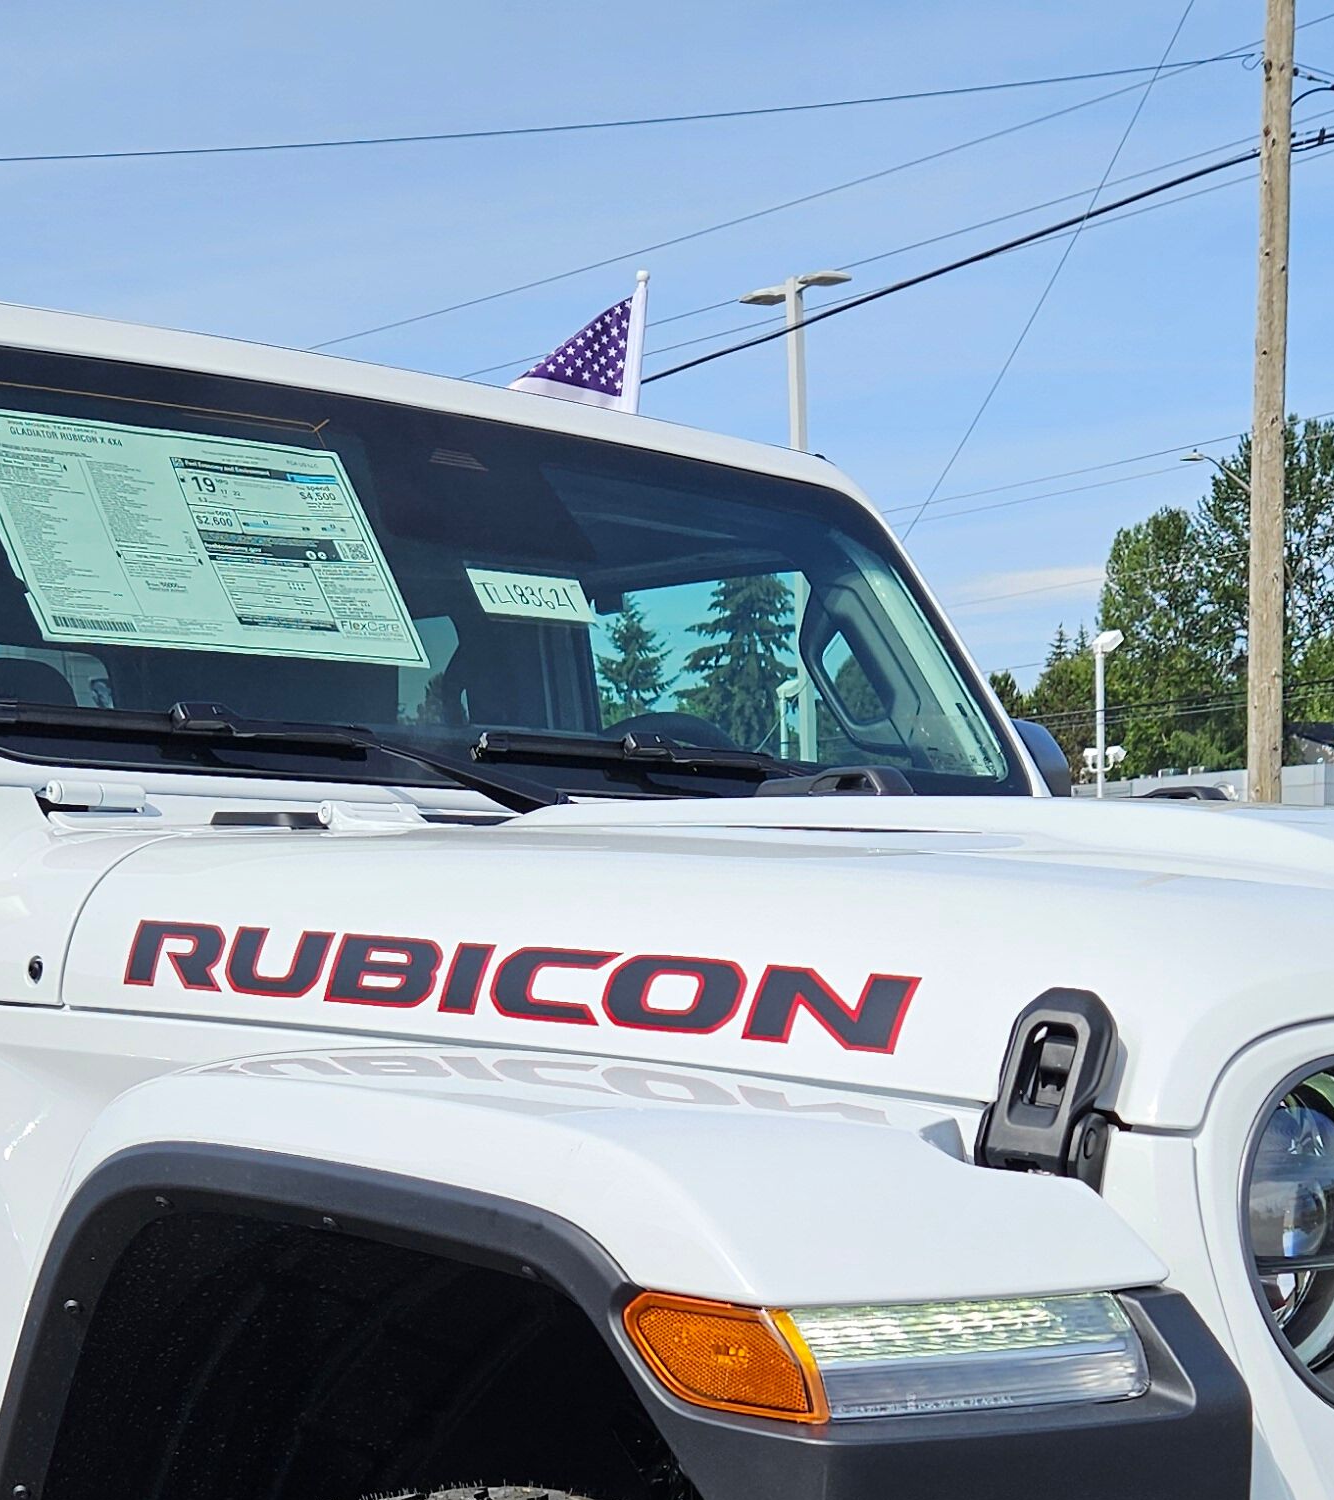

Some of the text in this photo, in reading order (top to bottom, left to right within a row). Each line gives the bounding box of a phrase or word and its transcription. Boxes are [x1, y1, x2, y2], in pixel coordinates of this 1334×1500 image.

[9, 426, 59, 440] GLADIATOR
[60, 430, 99, 444] RUBICON
[107, 436, 123, 447] 4X4
[191, 475, 216, 494] 19
[298, 491, 337, 502] $4,500
[195, 514, 234, 528] $2,600
[475, 582, 578, 613] TL183621
[340, 619, 401, 632] FlexCare
[123, 919, 923, 1055] RUBICON
